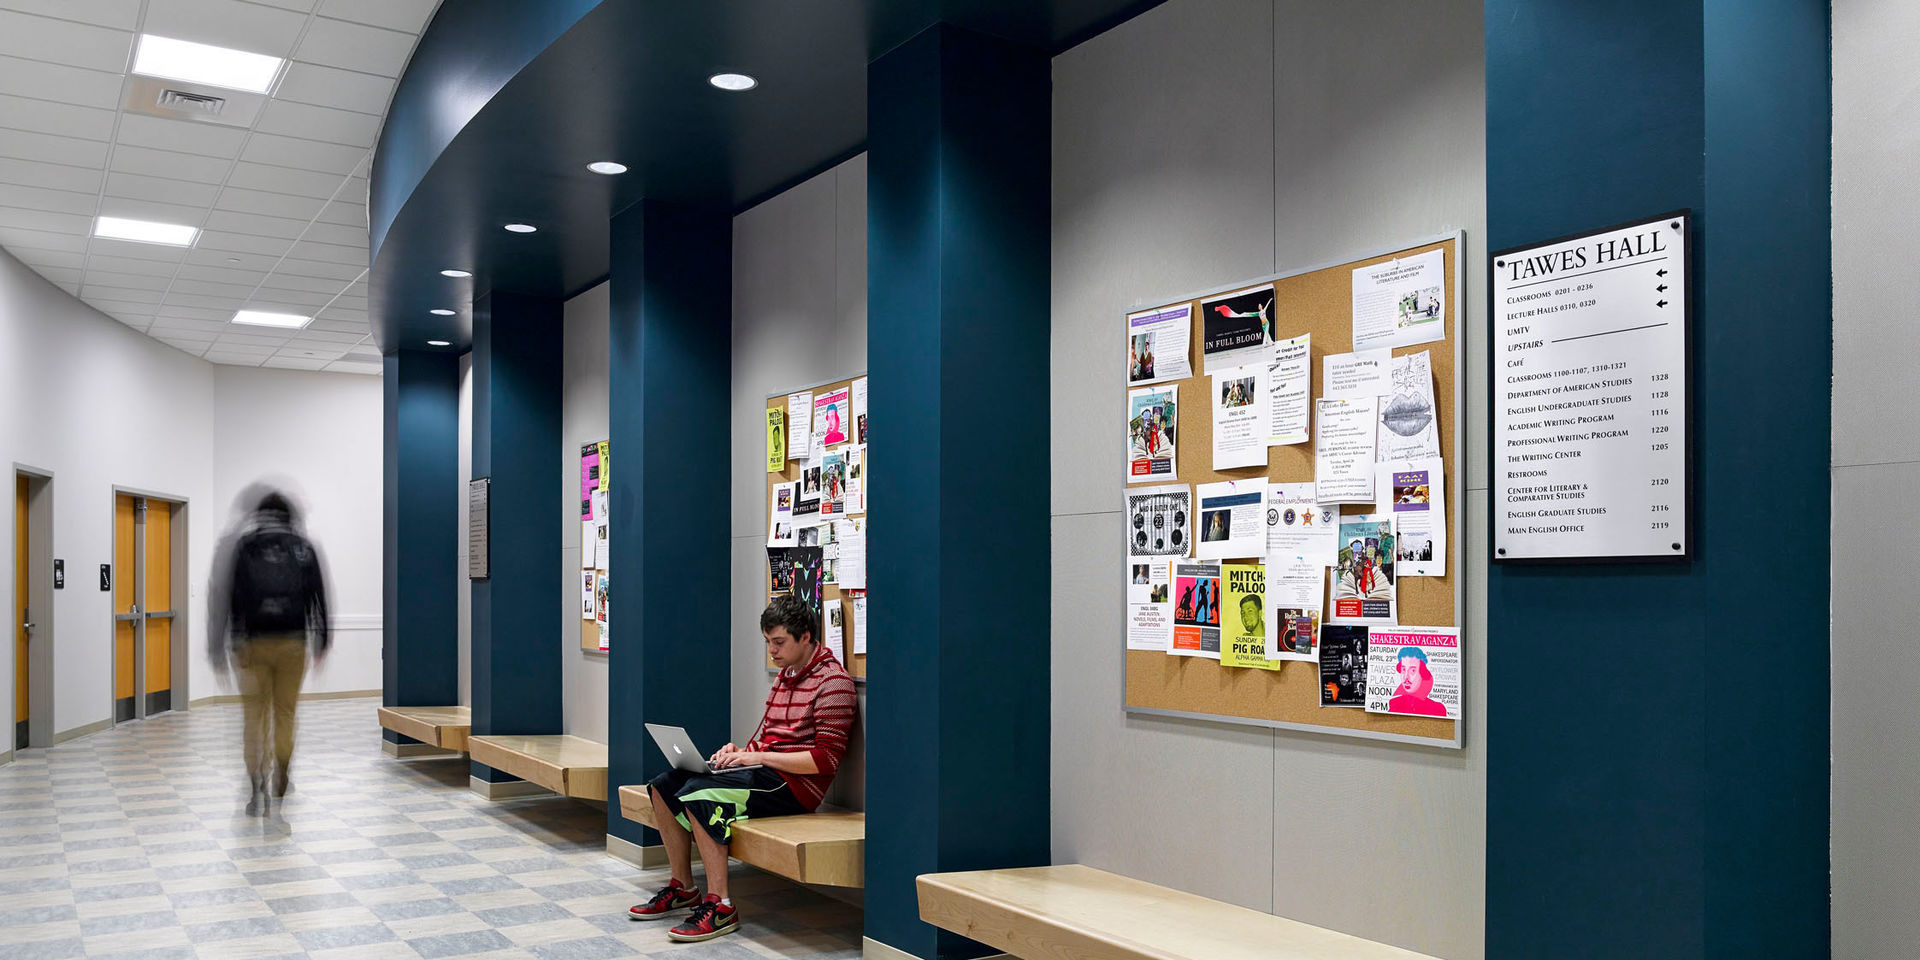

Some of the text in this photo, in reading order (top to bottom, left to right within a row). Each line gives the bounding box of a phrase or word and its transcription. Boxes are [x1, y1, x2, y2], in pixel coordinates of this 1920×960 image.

[1508, 231, 1666, 281] TAWES HALL
[1507, 291, 1551, 304] CLASSROOMS
[1555, 287, 1570, 295] 0201
[1577, 283, 1593, 291] 0236
[1507, 299, 1596, 320] LECTURE HALLS 0310, 0320
[1507, 326, 1530, 336] UMTV
[1206, 341, 1213, 350] IN
[1216, 337, 1234, 348] FULL
[1236, 332, 1262, 341] BLOOM
[1508, 340, 1543, 352] UPSTAIRS
[1507, 371, 1552, 383] CLASSROOMS
[1592, 362, 1627, 372] 1310-1321
[1507, 388, 1550, 399] DEPARTMENT
[1563, 382, 1600, 392] AMERICAN
[1602, 378, 1632, 388] STUDIES
[1651, 391, 1668, 399] 1128
[1508, 395, 1632, 415] ENGLISH UNDERGRADUATE STUDIES
[1508, 414, 1614, 431] ACADEMIC WRITING PROGRAM
[1508, 430, 1628, 447] PROFESSIONAL WRITING PROGRAM
[1508, 451, 1581, 463] THE WRITING CENTER
[1508, 470, 1547, 478] RESTROOMS
[1651, 478, 1668, 486] 2120
[1550, 484, 1581, 492] LITERARY
[1508, 492, 1585, 502] COMPARATIVE STUDIES
[1508, 507, 1606, 518] ENGLISH GRADUATE STUDIES
[1528, 526, 1557, 534] ENGLISH
[1231, 582, 1265, 593] PALOO
[1370, 634, 1457, 646] SHAKESTRAVAGANZA!
[1233, 644, 1265, 655] PIG ROA
[1370, 665, 1396, 674] TAWES
[1370, 676, 1395, 685] PLAZA
[1369, 687, 1392, 696] NOON
[1370, 702, 1388, 711] 4PM
